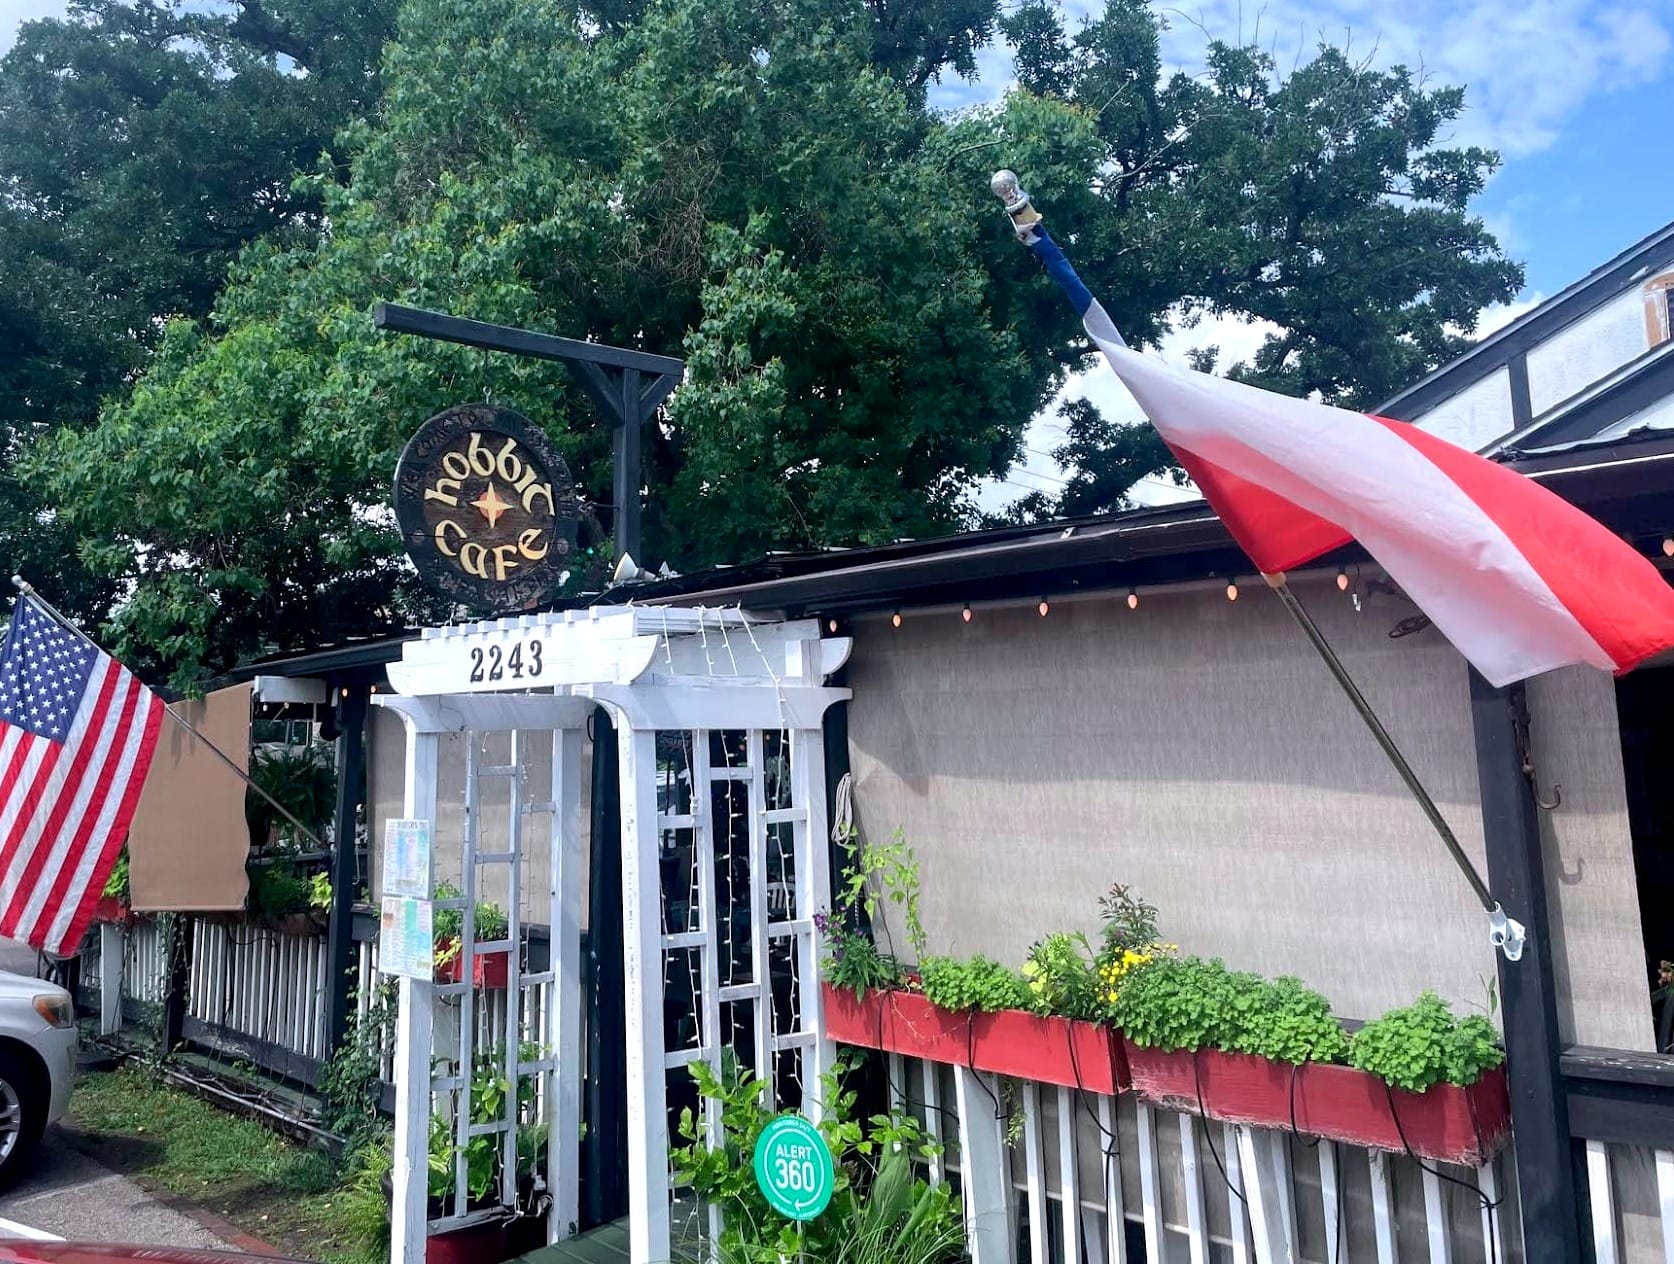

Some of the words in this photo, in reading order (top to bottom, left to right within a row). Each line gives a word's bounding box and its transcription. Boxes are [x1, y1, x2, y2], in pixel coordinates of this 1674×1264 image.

[470, 640, 542, 683] 2243
[776, 1144, 812, 1160] ALERT
[775, 1158, 815, 1193] 360
